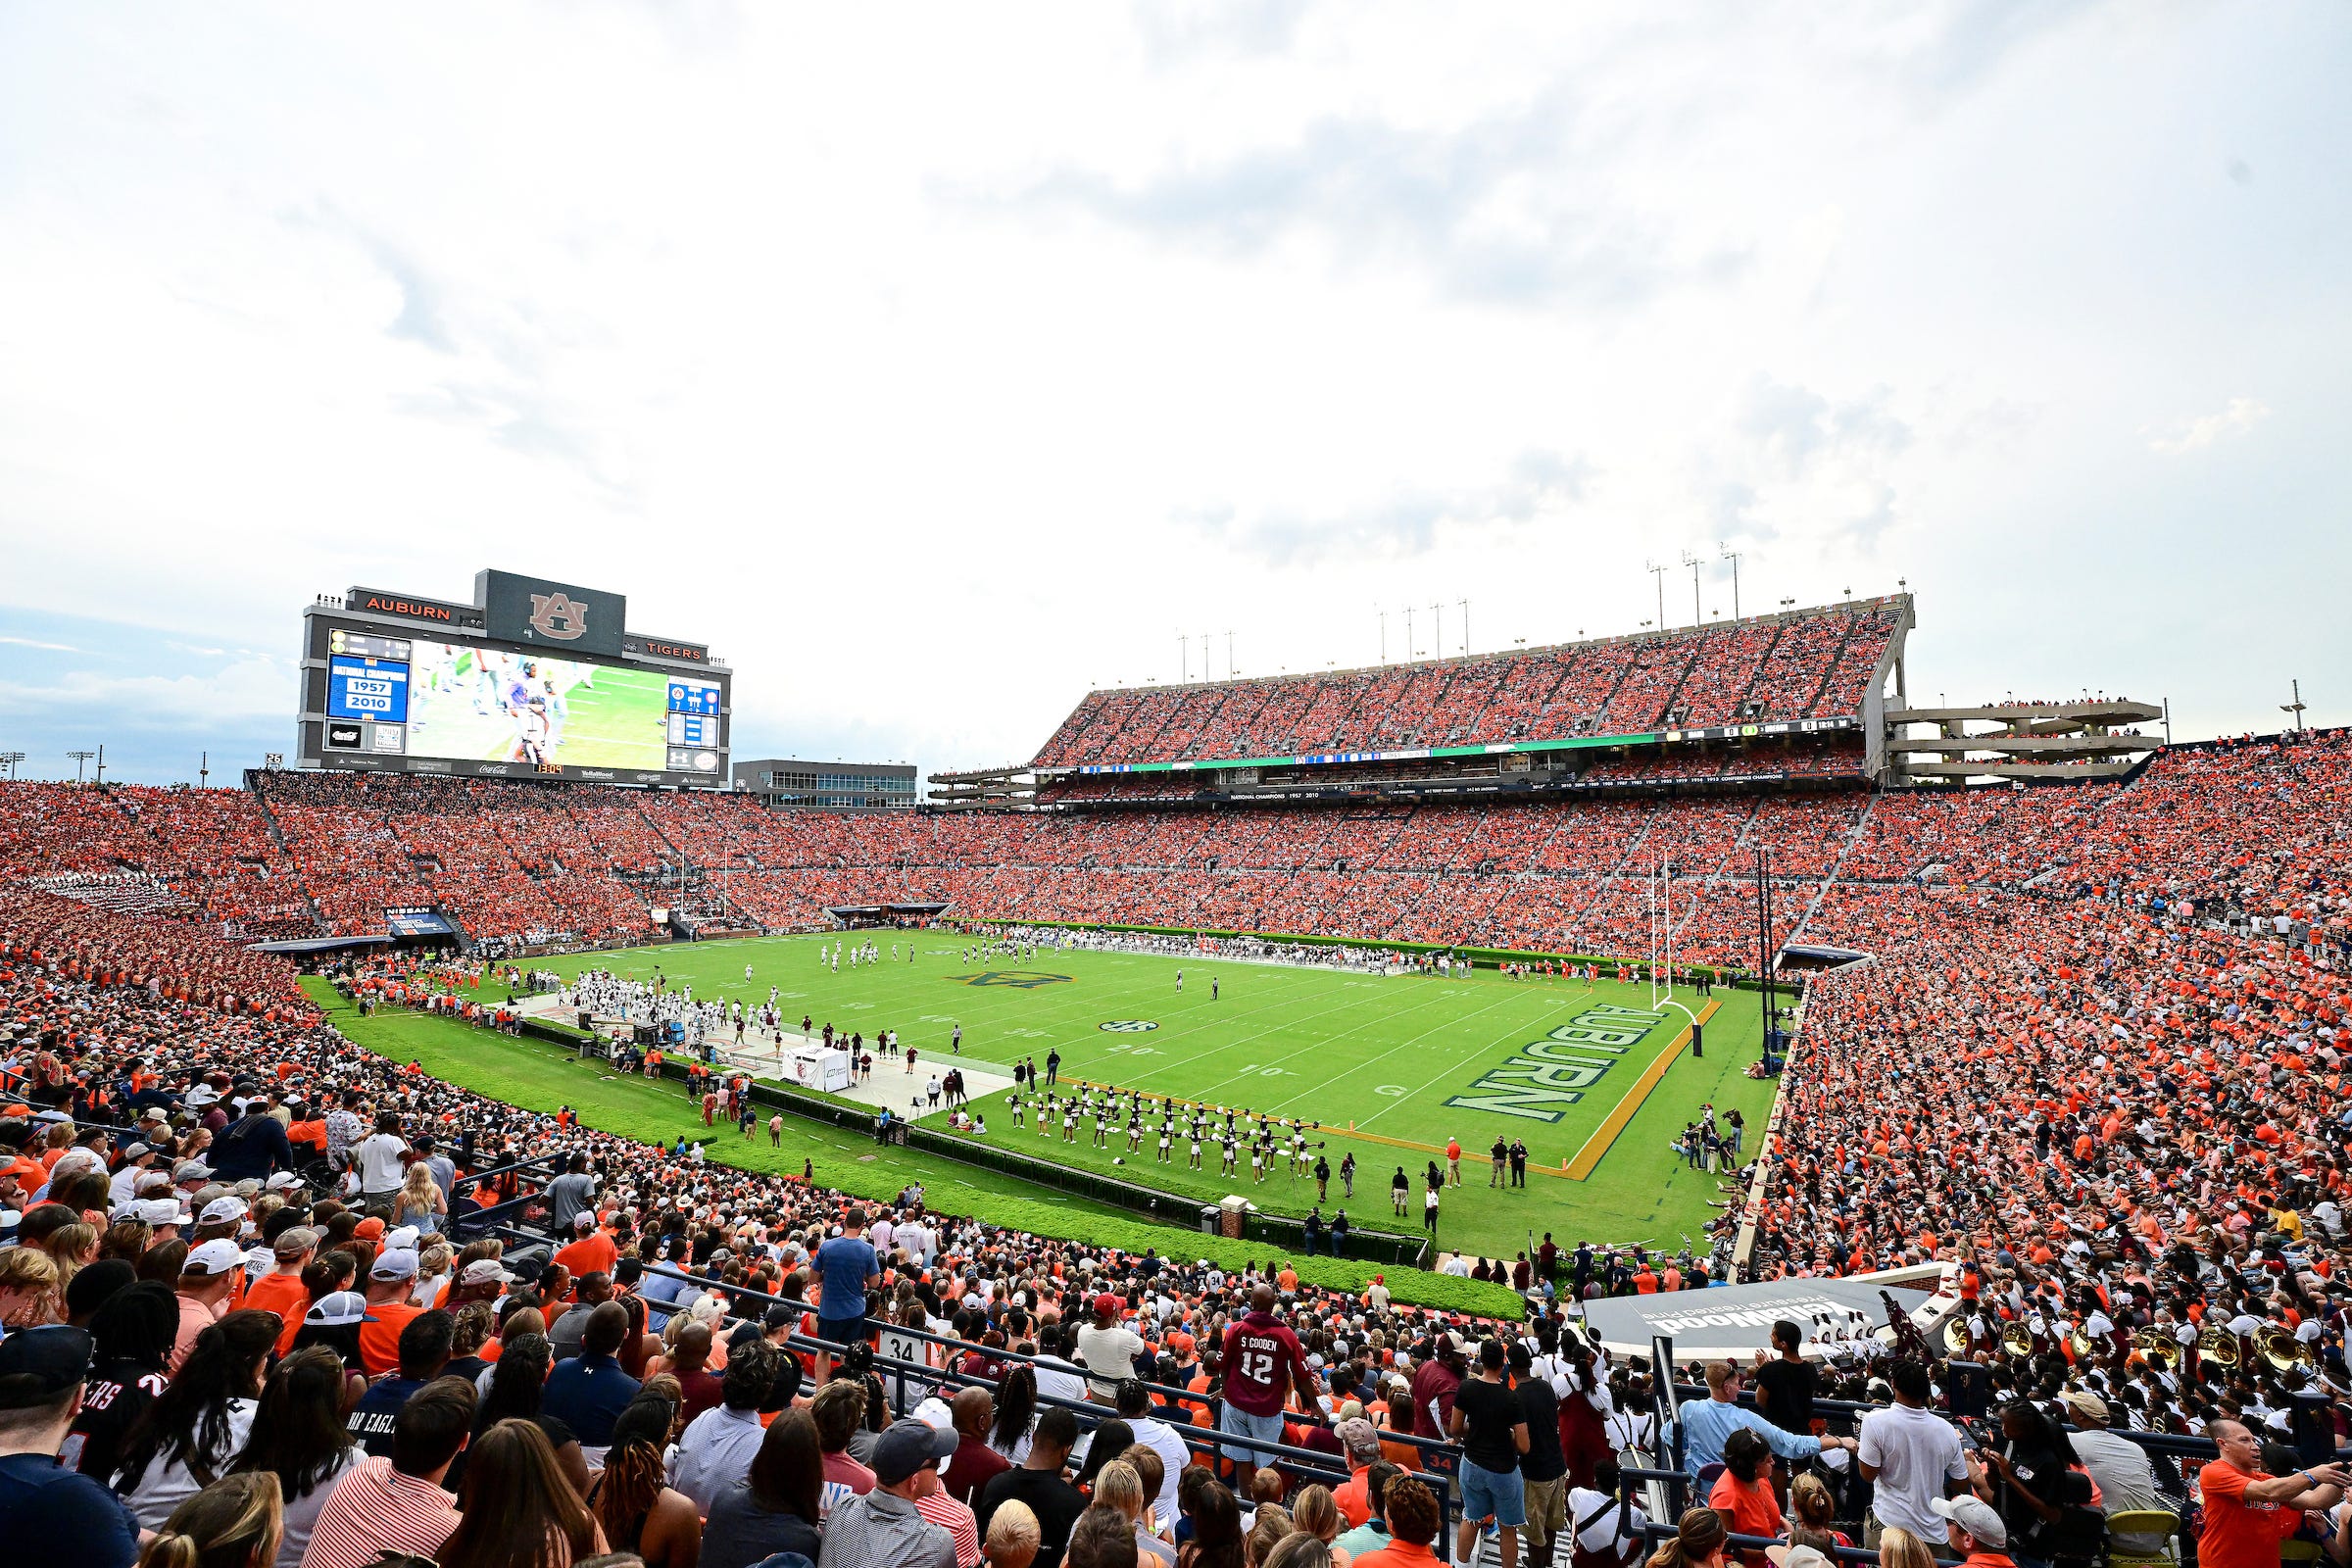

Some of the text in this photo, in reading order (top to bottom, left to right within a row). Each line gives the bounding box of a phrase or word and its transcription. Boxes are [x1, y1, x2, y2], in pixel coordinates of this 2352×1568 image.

[367, 598, 450, 619] AUBURN
[647, 643, 701, 659] TIGERS
[353, 681, 386, 692] 1957
[351, 697, 386, 708] 2010
[267, 754, 281, 762] 26
[538, 764, 562, 773] 13:09
[1106, 1044, 1154, 1055] 20
[1239, 1064, 1284, 1076] 10
[1440, 1003, 1670, 1124] AUBURN
[1374, 1084, 1408, 1097] G
[1642, 1295, 1830, 1321] Pressure Treated Pine
[1648, 1300, 1866, 1335] YellaWood
[890, 1338, 914, 1362] 34
[1241, 1336, 1277, 1351] S GOODEN
[1241, 1351, 1273, 1385] 12
[1429, 1452, 1452, 1471] 34
